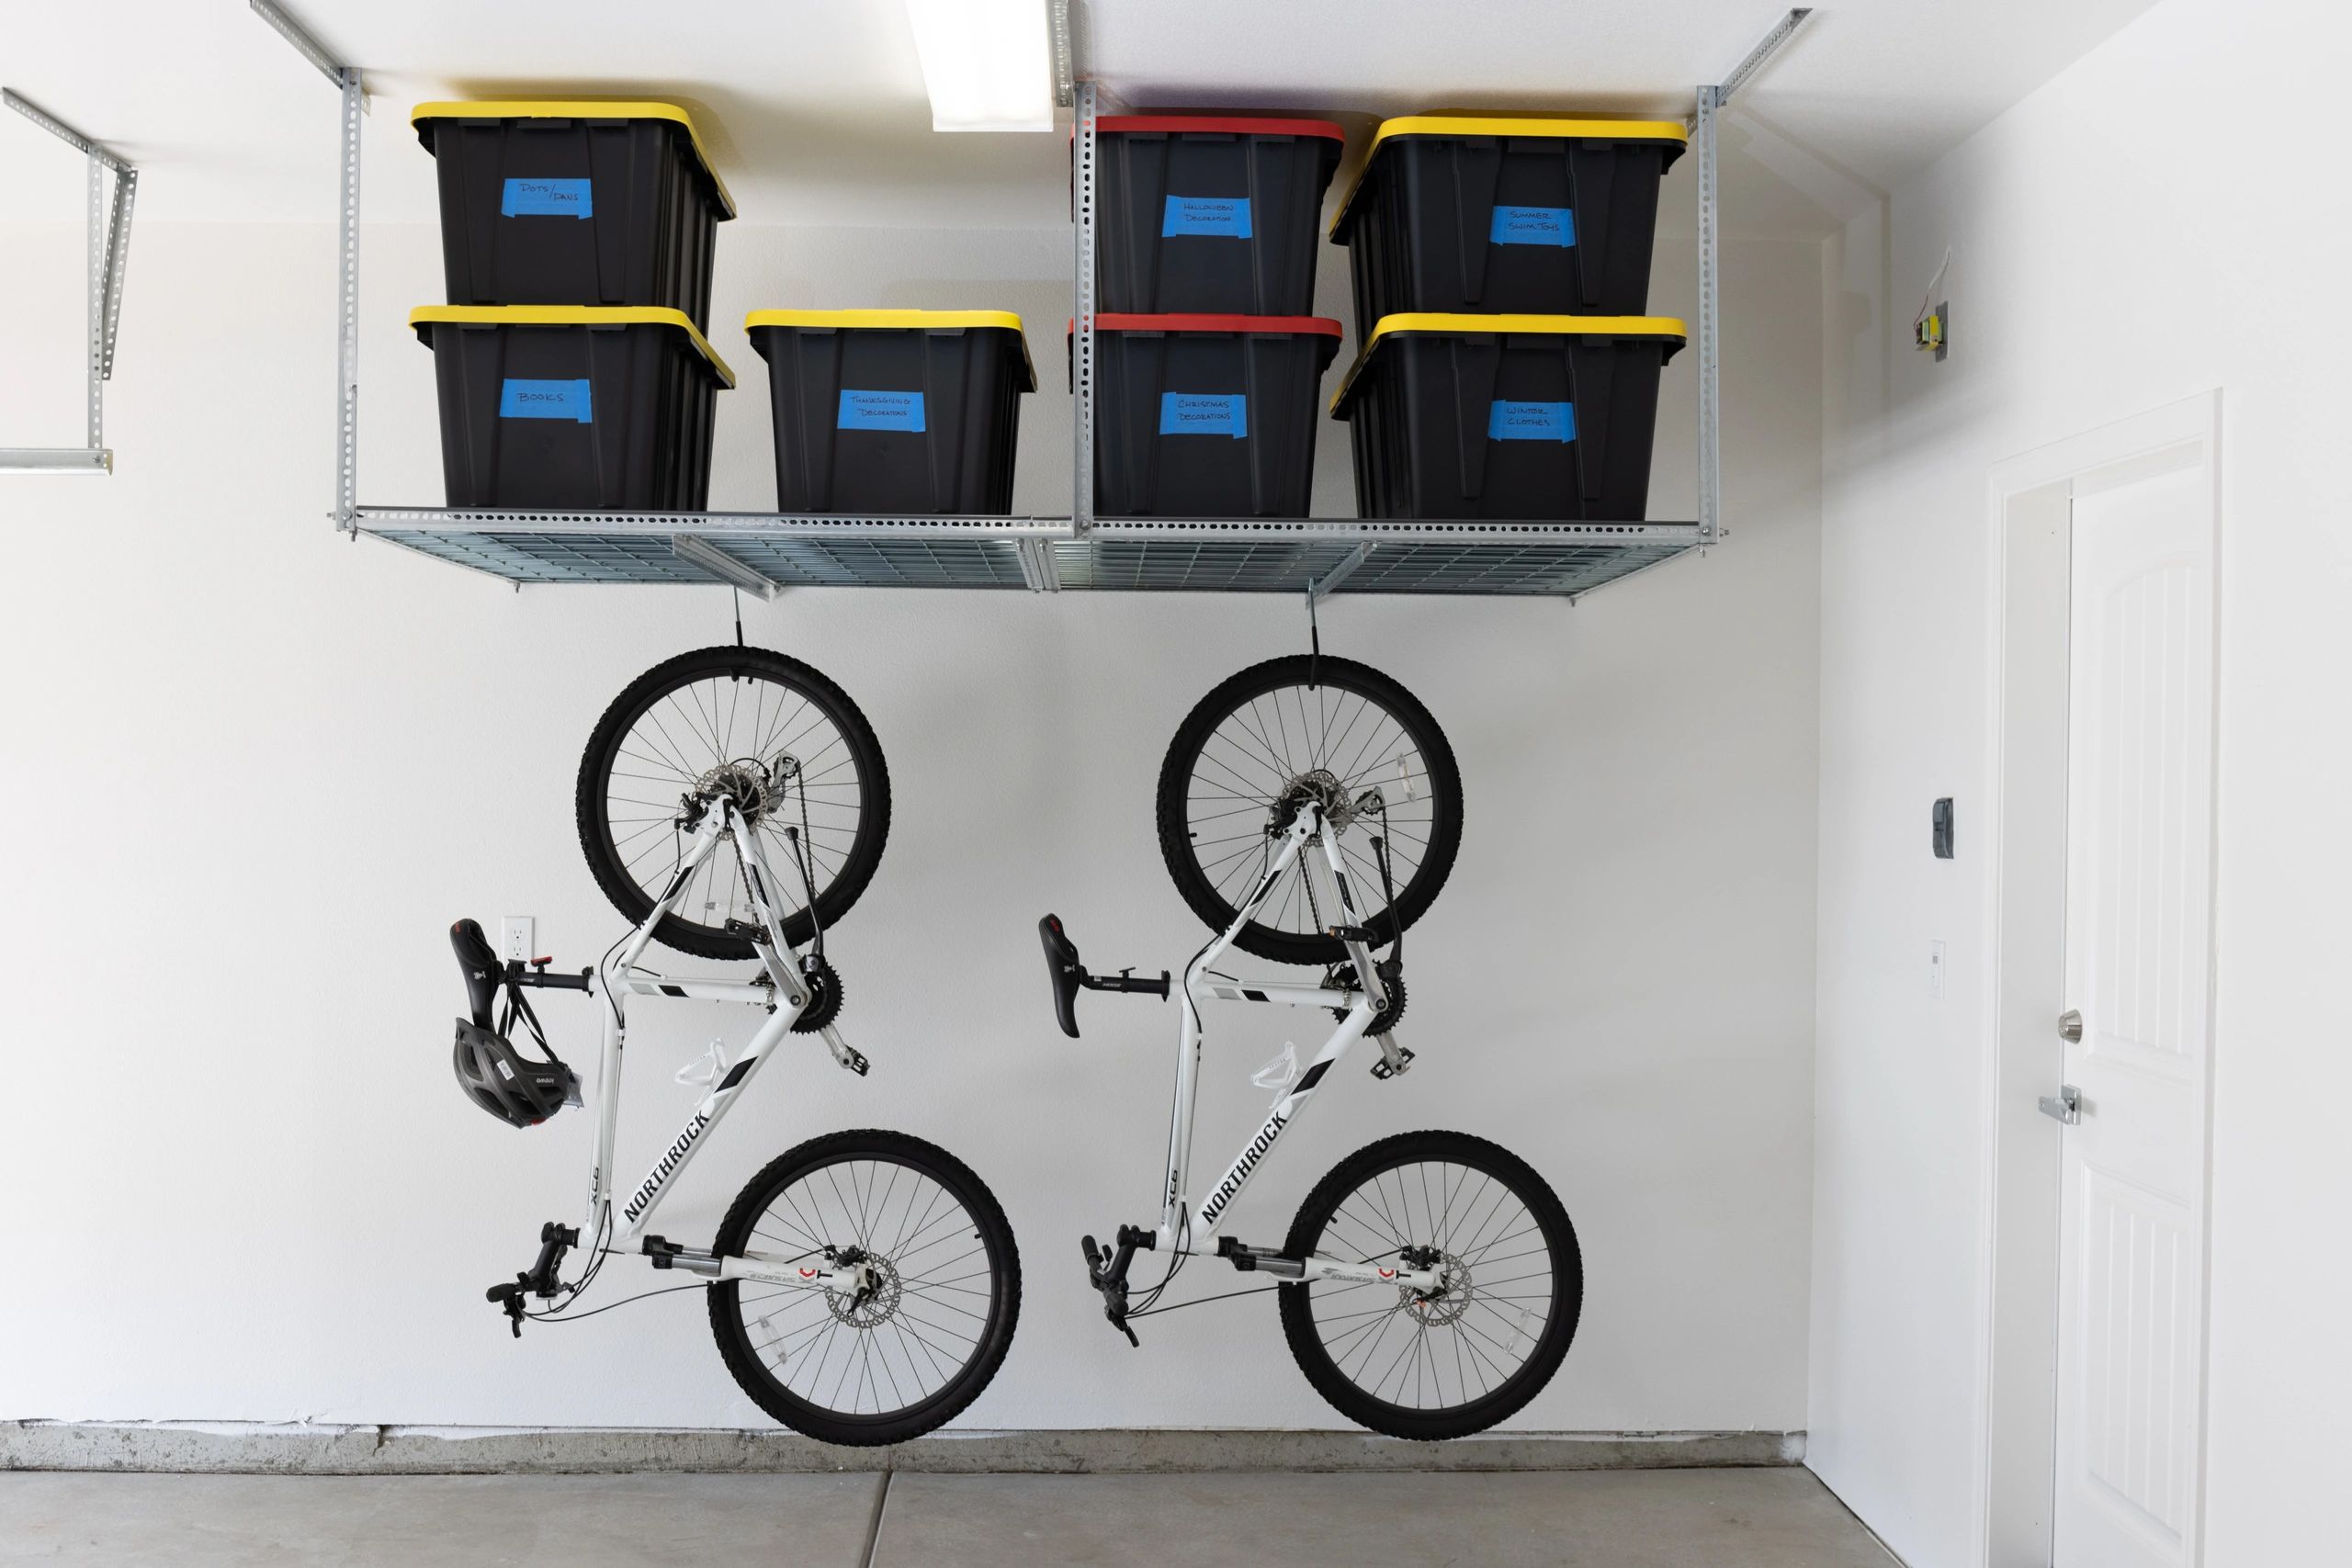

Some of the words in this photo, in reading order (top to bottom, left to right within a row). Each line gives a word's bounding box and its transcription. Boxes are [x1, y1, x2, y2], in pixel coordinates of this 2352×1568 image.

[1509, 210, 1552, 220] SUMMER
[1508, 221, 1536, 231] SWIM
[516, 392, 564, 402] BOOKS
[848, 395, 911, 405] THANKSGIVING
[1177, 399, 1229, 409] CHRISTMAS
[1507, 405, 1549, 415] WINTER
[1178, 412, 1231, 421] DECORATIONS
[1507, 417, 1551, 427] CLOTHES
[624, 1110, 710, 1224] NORTHROCK
[1202, 1111, 1288, 1225] NORTHROCK
